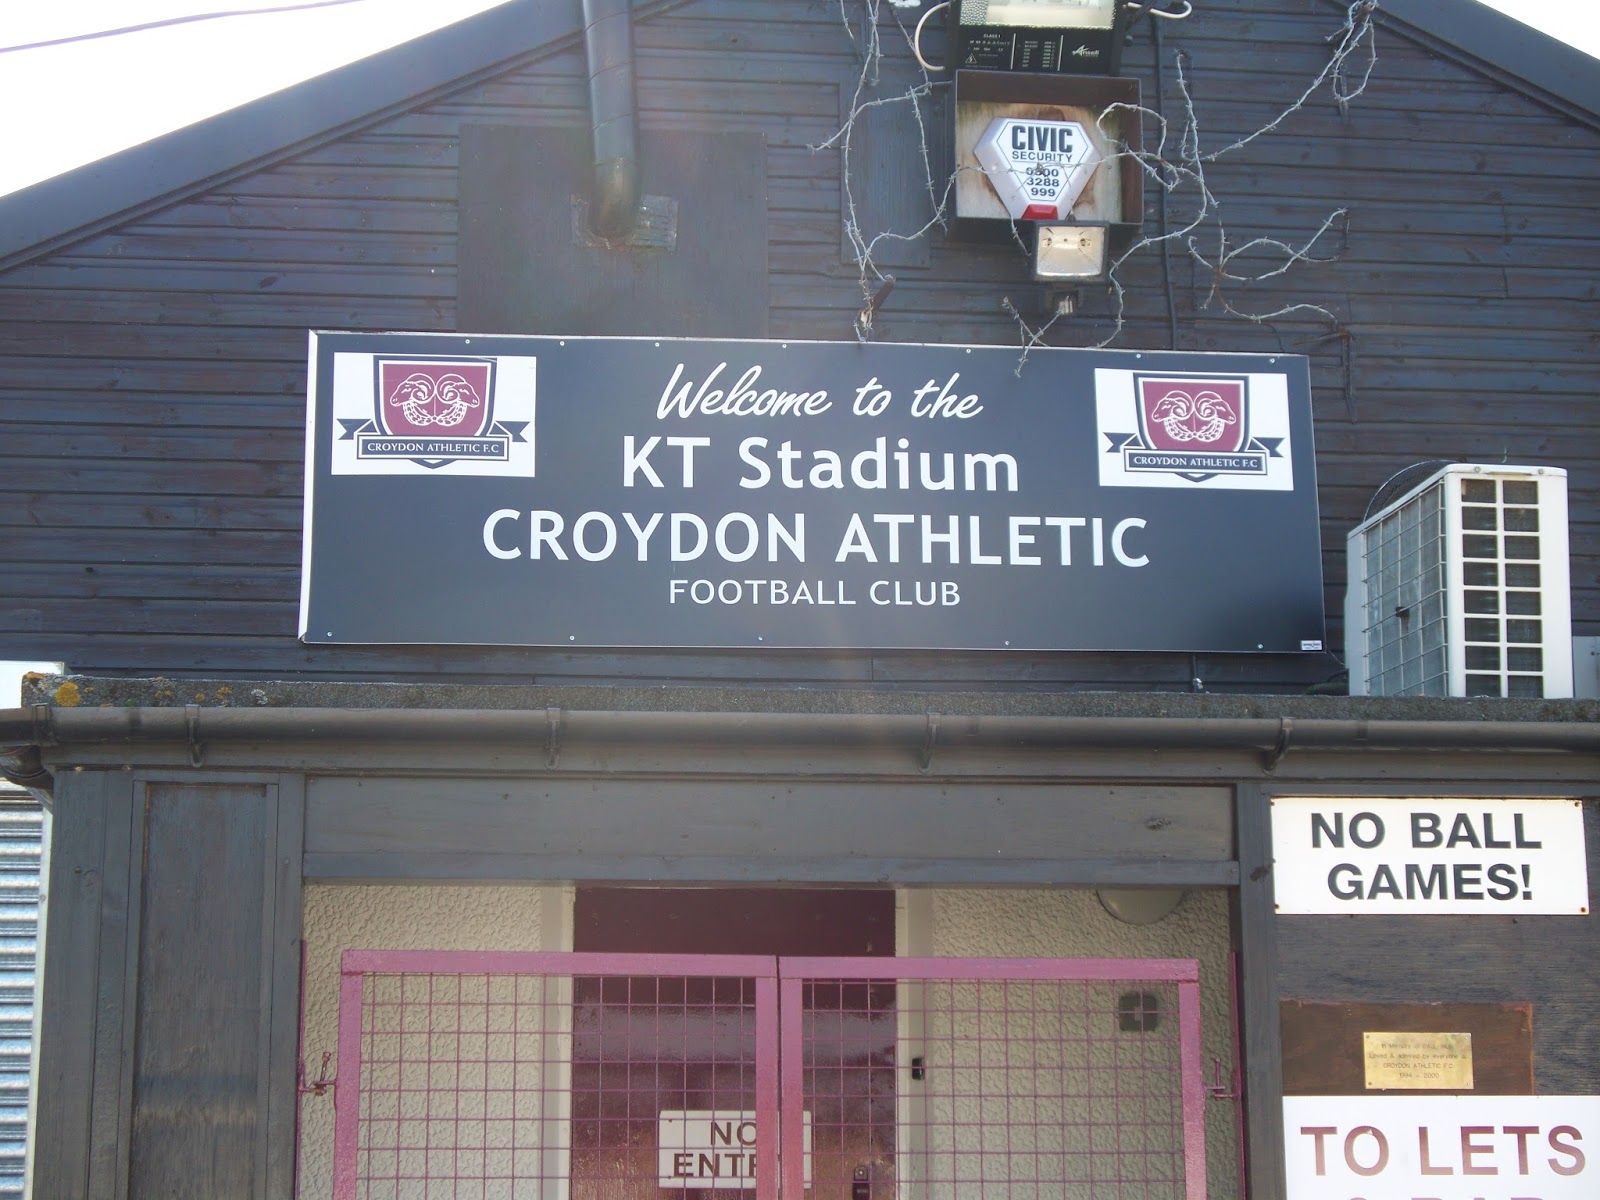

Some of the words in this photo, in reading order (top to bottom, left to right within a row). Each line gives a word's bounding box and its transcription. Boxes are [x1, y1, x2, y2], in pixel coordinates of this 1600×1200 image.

[1012, 125, 1073, 153] CIVIC
[1012, 151, 1073, 162] SECURITY
[1026, 177, 1059, 187] 3288
[1031, 187, 1055, 197] 999
[656, 362, 833, 419] Welcome
[851, 376, 892, 417] to
[910, 372, 984, 419] the
[367, 442, 424, 452] CROYDON
[427, 443, 481, 453] ATHLETIC
[622, 435, 711, 488] KT
[738, 436, 1019, 492] Stadium
[1134, 456, 1187, 466] CROYDON
[1190, 457, 1241, 467] ATHLETIC
[483, 508, 805, 563] CROYDON
[834, 513, 1150, 567] ATHLETIC
[669, 579, 857, 605] FOOTBALL
[869, 580, 961, 606] CLUB
[1311, 812, 1386, 849] NO
[1410, 812, 1543, 849] BALL
[1327, 863, 1533, 901] GAMES!
[710, 1121, 757, 1146] NO
[1300, 1125, 1390, 1177] TO
[1418, 1125, 1586, 1177] LETS
[673, 1153, 757, 1177] ENT
